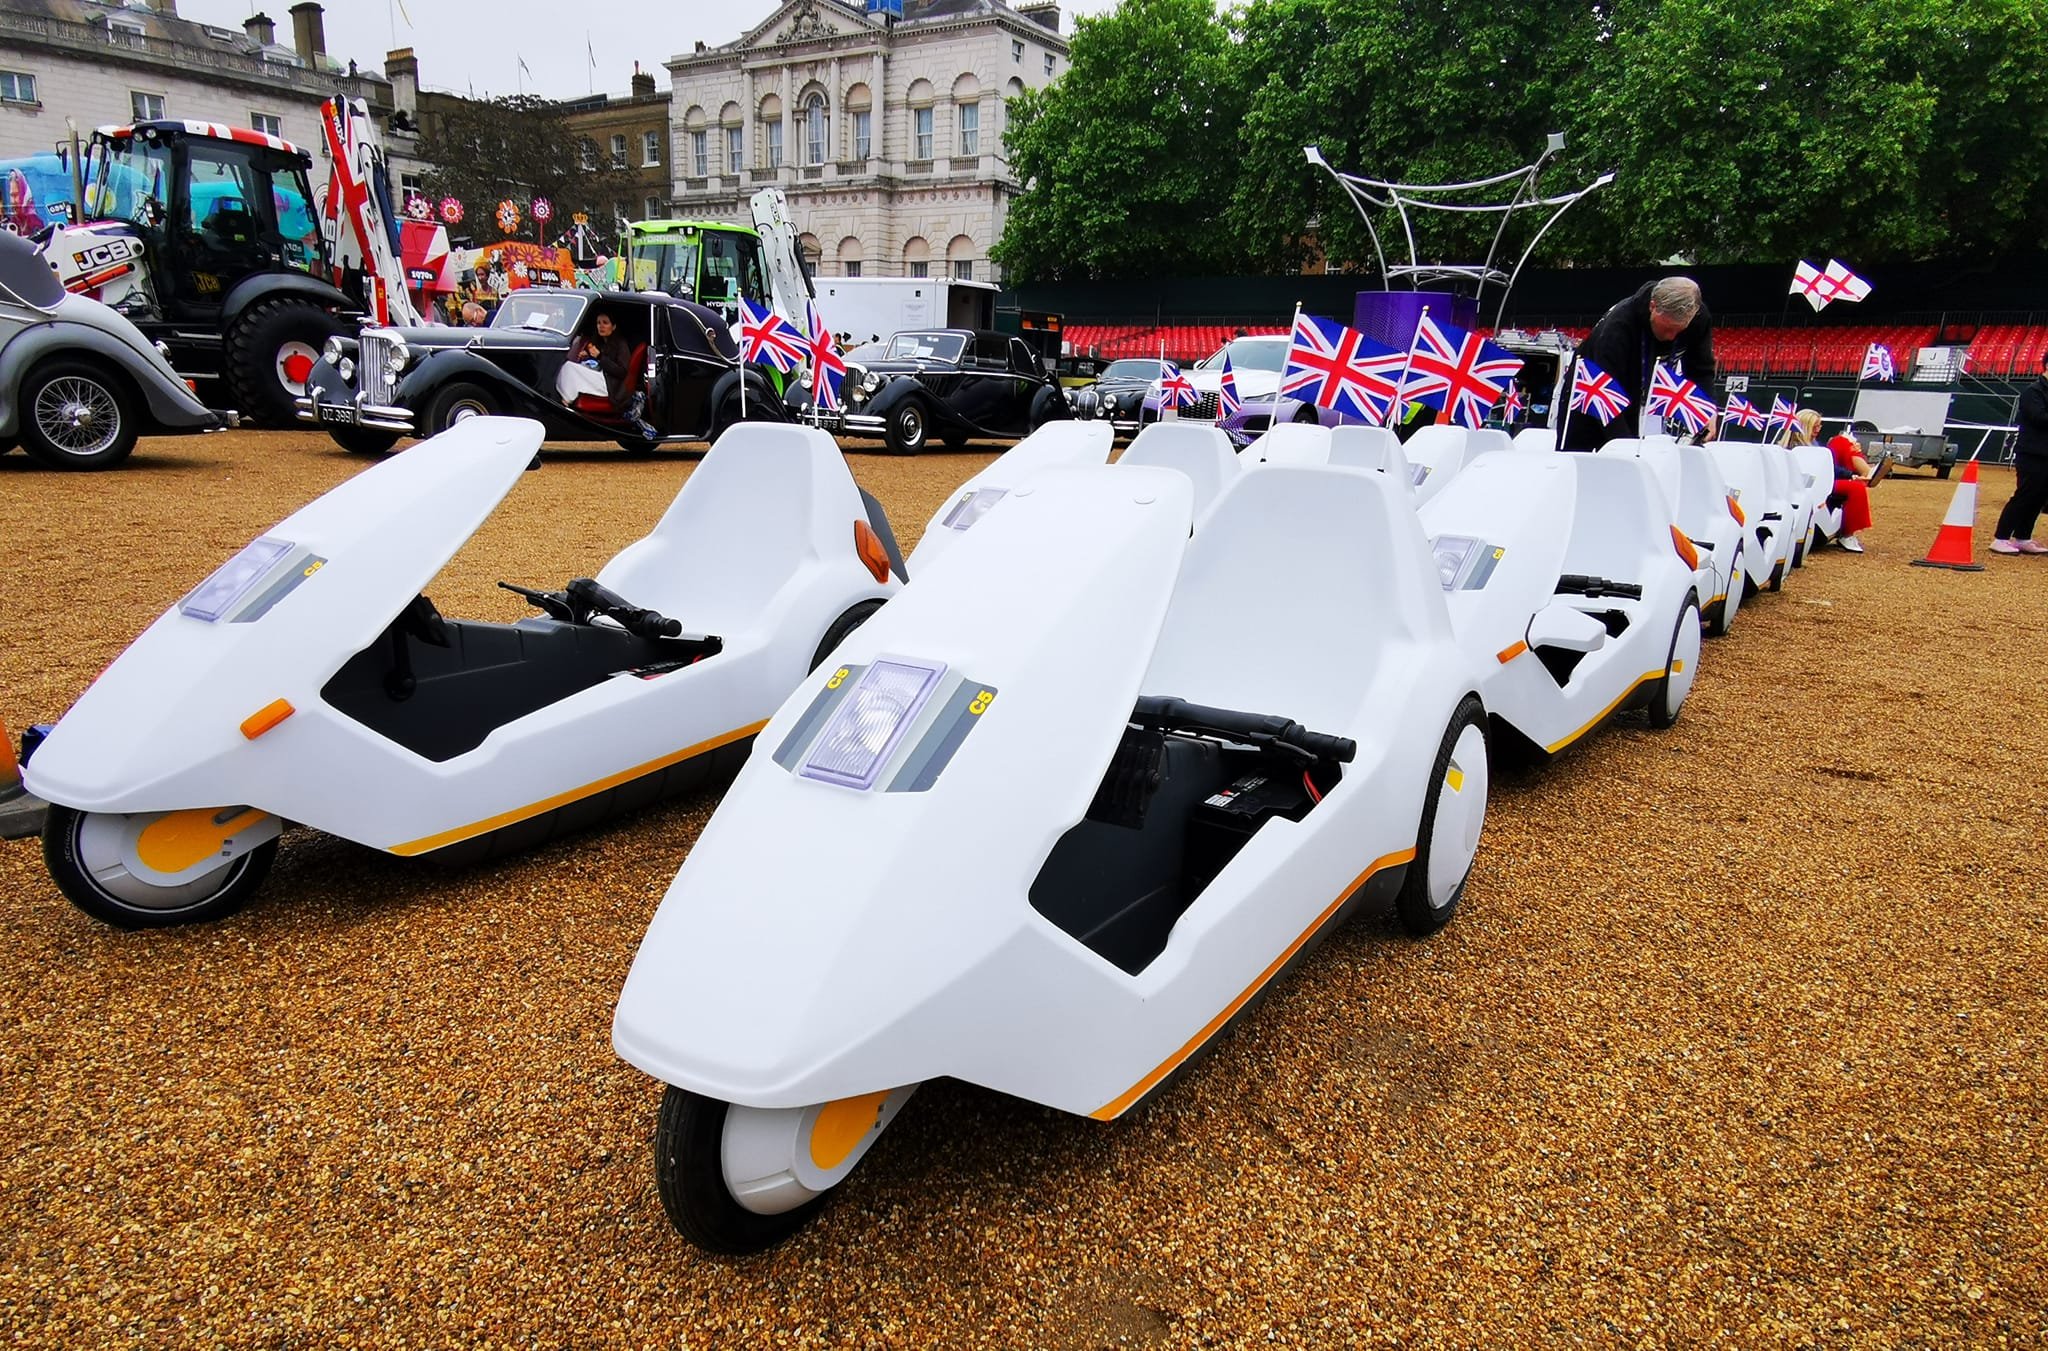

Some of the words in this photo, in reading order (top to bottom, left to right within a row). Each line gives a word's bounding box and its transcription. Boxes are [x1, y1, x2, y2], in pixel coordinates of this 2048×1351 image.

[636, 233, 688, 243] HYDROGEN
[78, 240, 131, 270] JCB
[197, 274, 219, 291] JCB
[410, 270, 433, 279] 1970s
[1728, 381, 1744, 391] J4
[303, 560, 323, 577] C5
[826, 668, 850, 689] C5
[968, 689, 994, 715] C5
